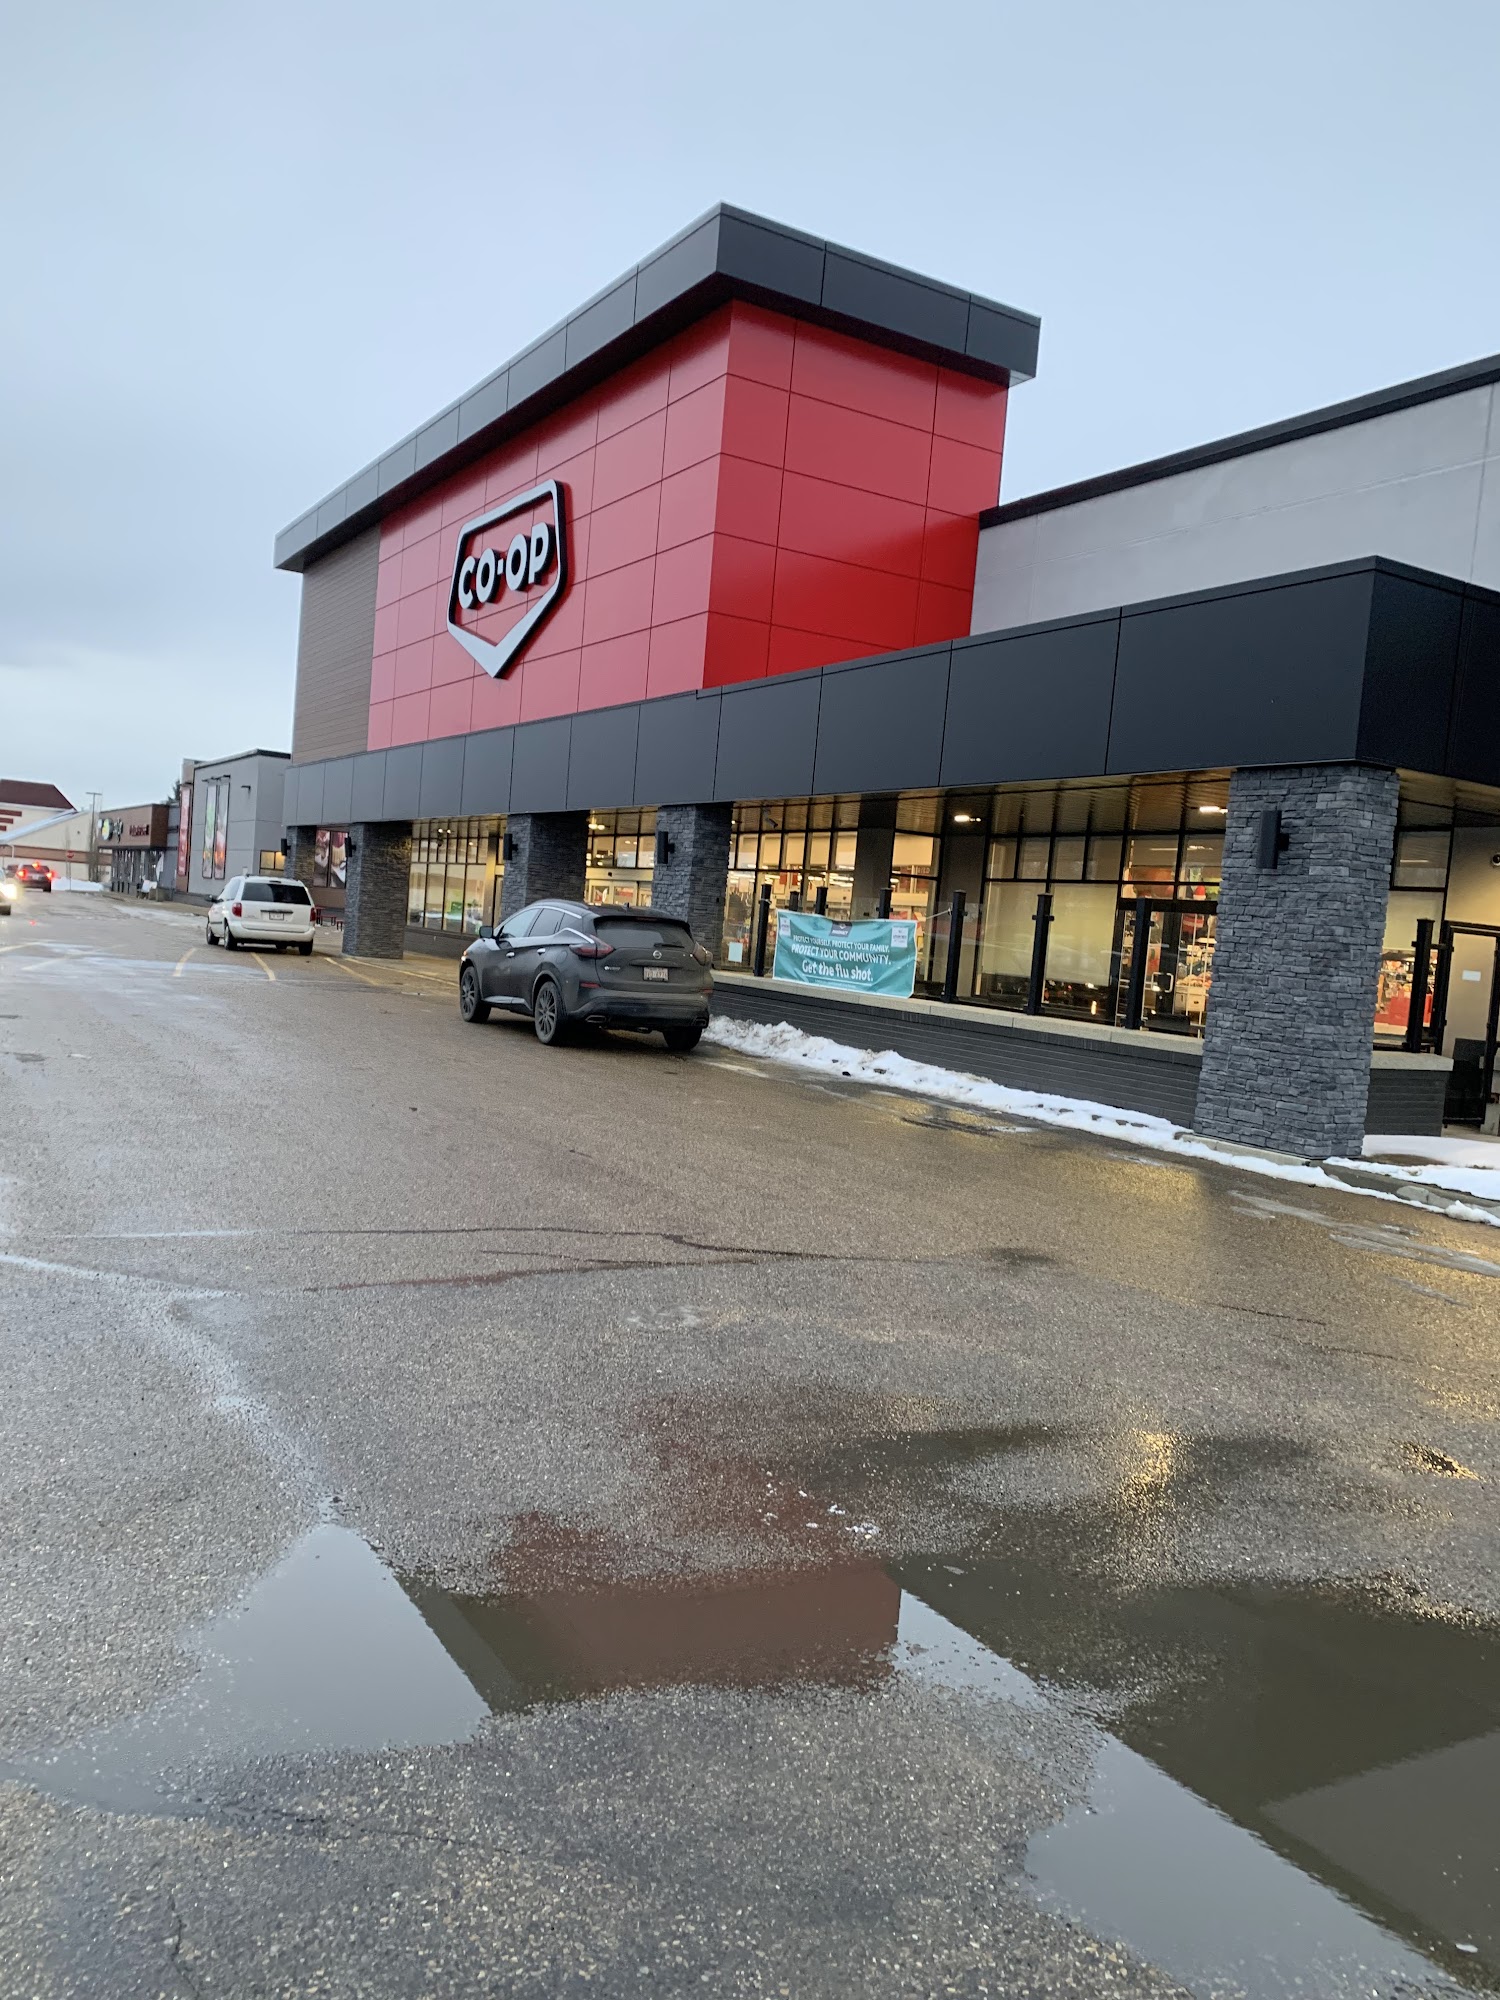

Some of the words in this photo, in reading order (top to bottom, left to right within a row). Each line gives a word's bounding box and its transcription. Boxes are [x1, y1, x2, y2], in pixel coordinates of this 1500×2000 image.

[458, 522, 552, 610] CO-OP
[791, 944, 819, 956] PROTECT
[820, 948, 838, 960] YOUR
[839, 950, 891, 965] COMMUNITY.
[832, 940, 853, 949] PROTECT
[854, 942, 869, 950] YOUR
[870, 943, 889, 953] FAMILY.
[802, 960, 817, 974] Get
[819, 961, 834, 976] the
[835, 963, 849, 979] flu
[851, 965, 873, 981] shot.
